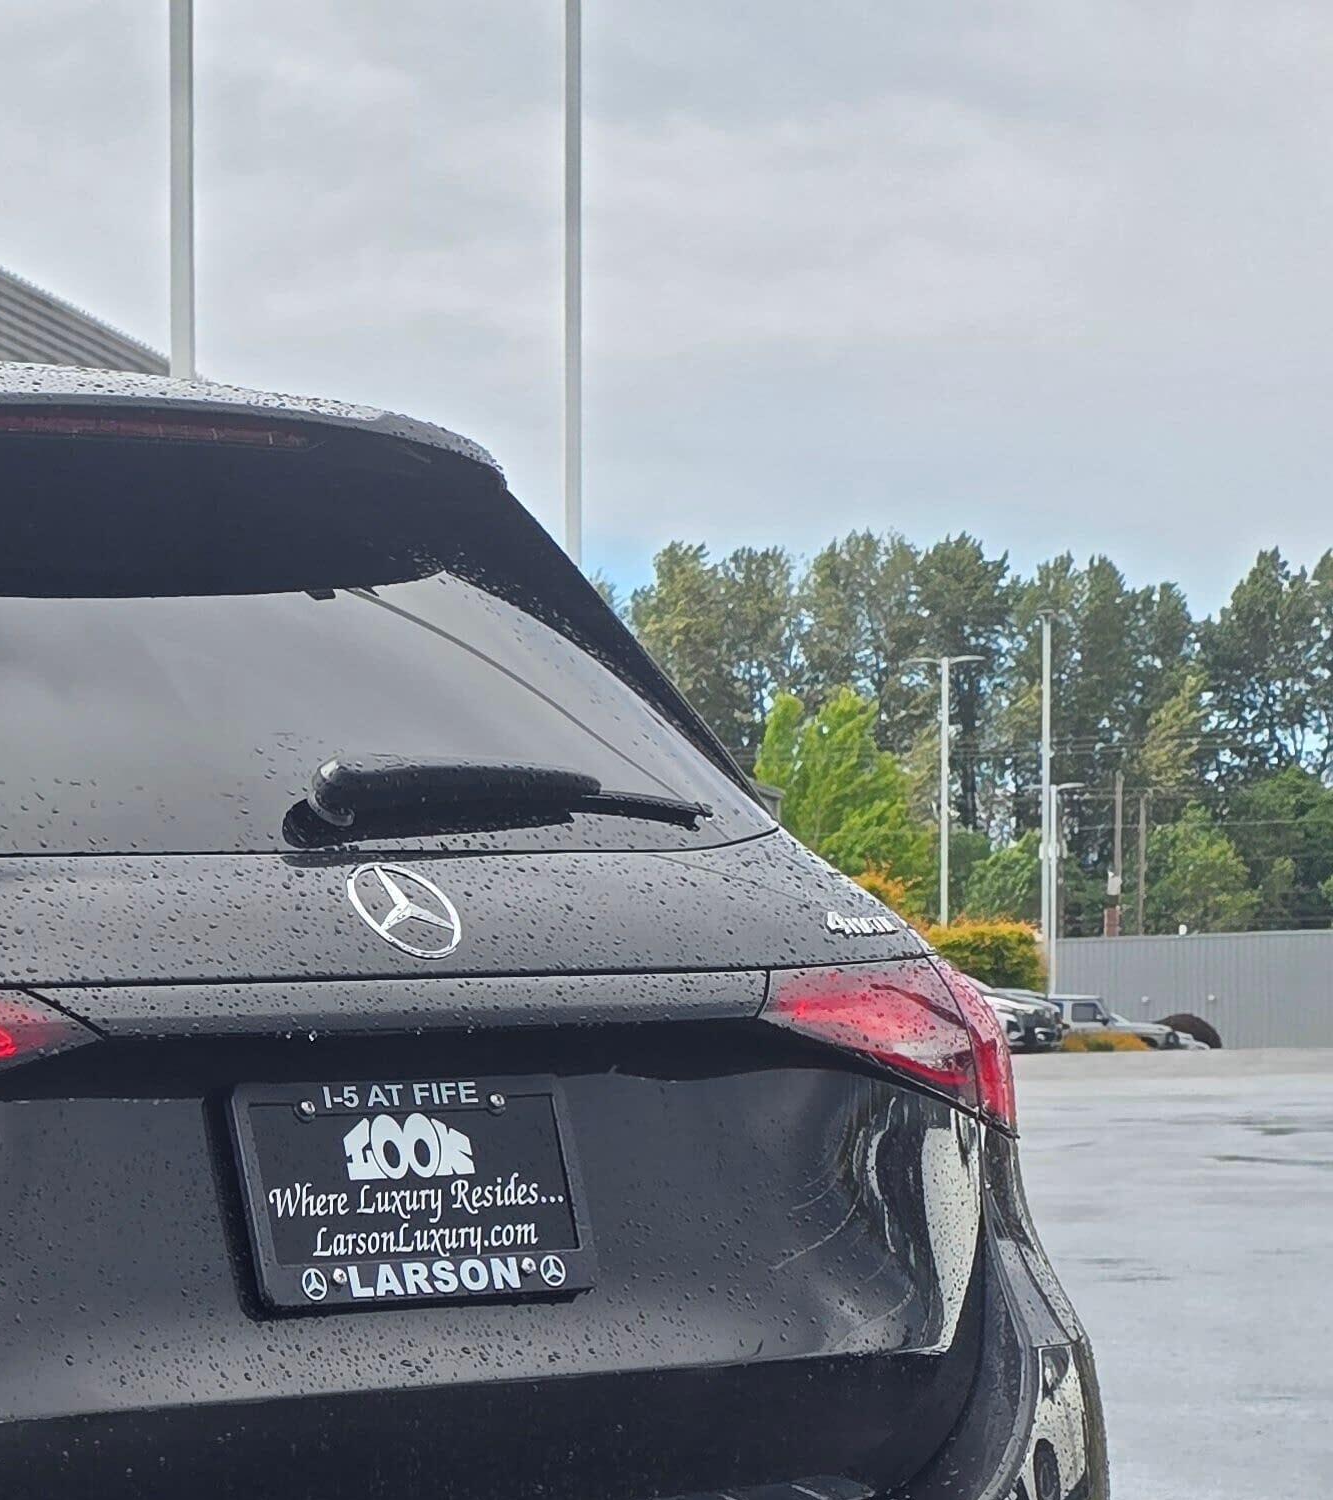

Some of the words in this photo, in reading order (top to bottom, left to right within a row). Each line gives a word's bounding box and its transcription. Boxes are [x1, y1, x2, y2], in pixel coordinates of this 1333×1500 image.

[322, 1085, 360, 1109] I-5
[367, 1083, 403, 1108] AT
[412, 1081, 479, 1107] FIFE
[342, 1112, 476, 1181] LOOK
[268, 1182, 349, 1219] Where
[356, 1184, 443, 1223] Luxury
[450, 1171, 565, 1215] Resides...
[312, 1221, 539, 1258] LarsonLuxury.com
[346, 1256, 522, 1298] LARSON
